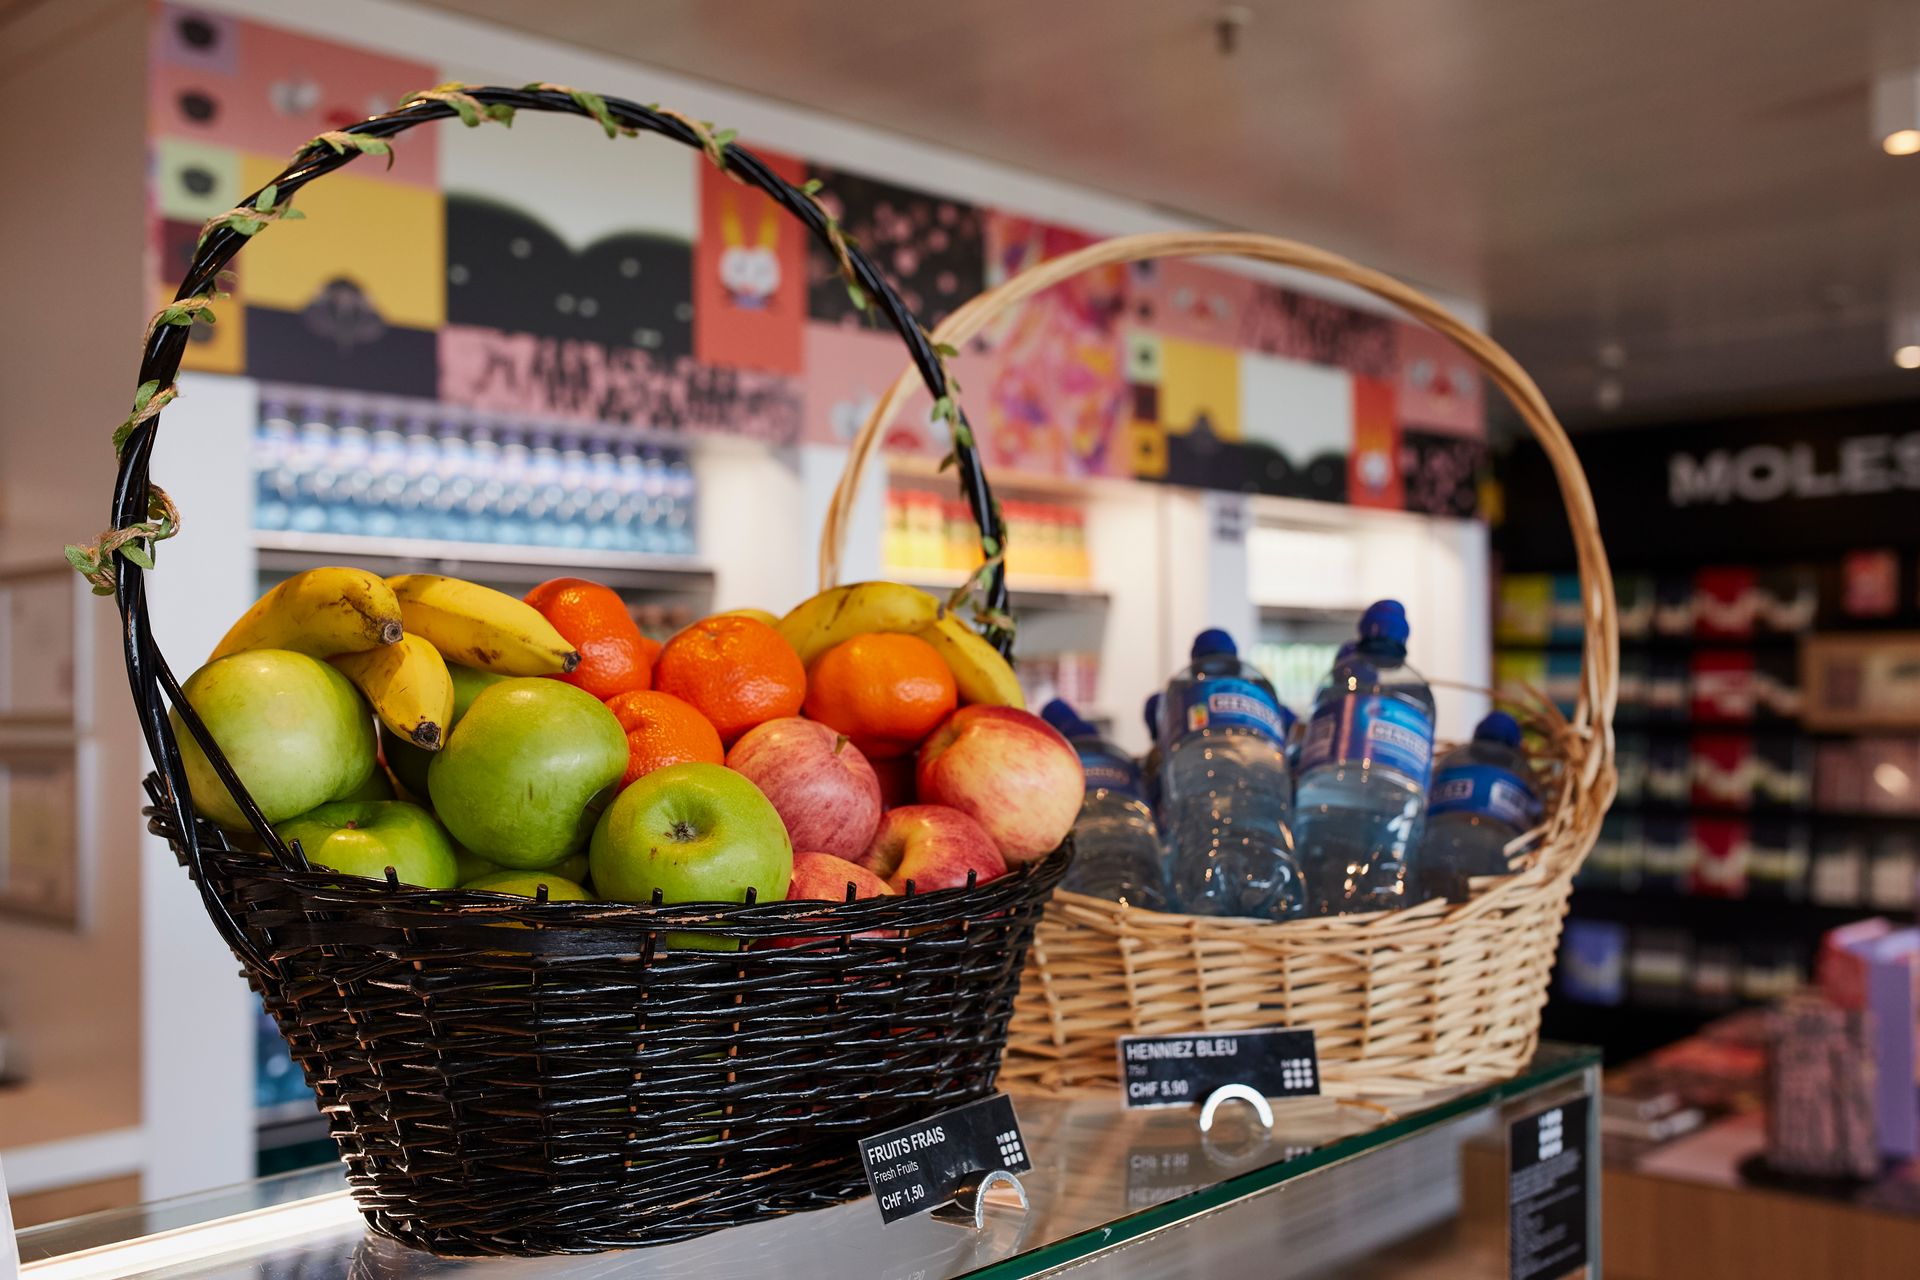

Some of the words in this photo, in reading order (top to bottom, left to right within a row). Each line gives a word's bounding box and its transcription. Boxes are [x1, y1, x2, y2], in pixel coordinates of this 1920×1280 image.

[1126, 1041, 1194, 1060] HENNIEZ
[1196, 1038, 1238, 1057] BLEU
[1129, 1081, 1158, 1098] CHF
[867, 1137, 911, 1165] FRUITS
[910, 1126, 946, 1151] FRAIS
[873, 1167, 897, 1184] Fresh
[896, 1160, 919, 1176] Fruits
[881, 1191, 902, 1210] CHF
[904, 1183, 925, 1204] 1,50
